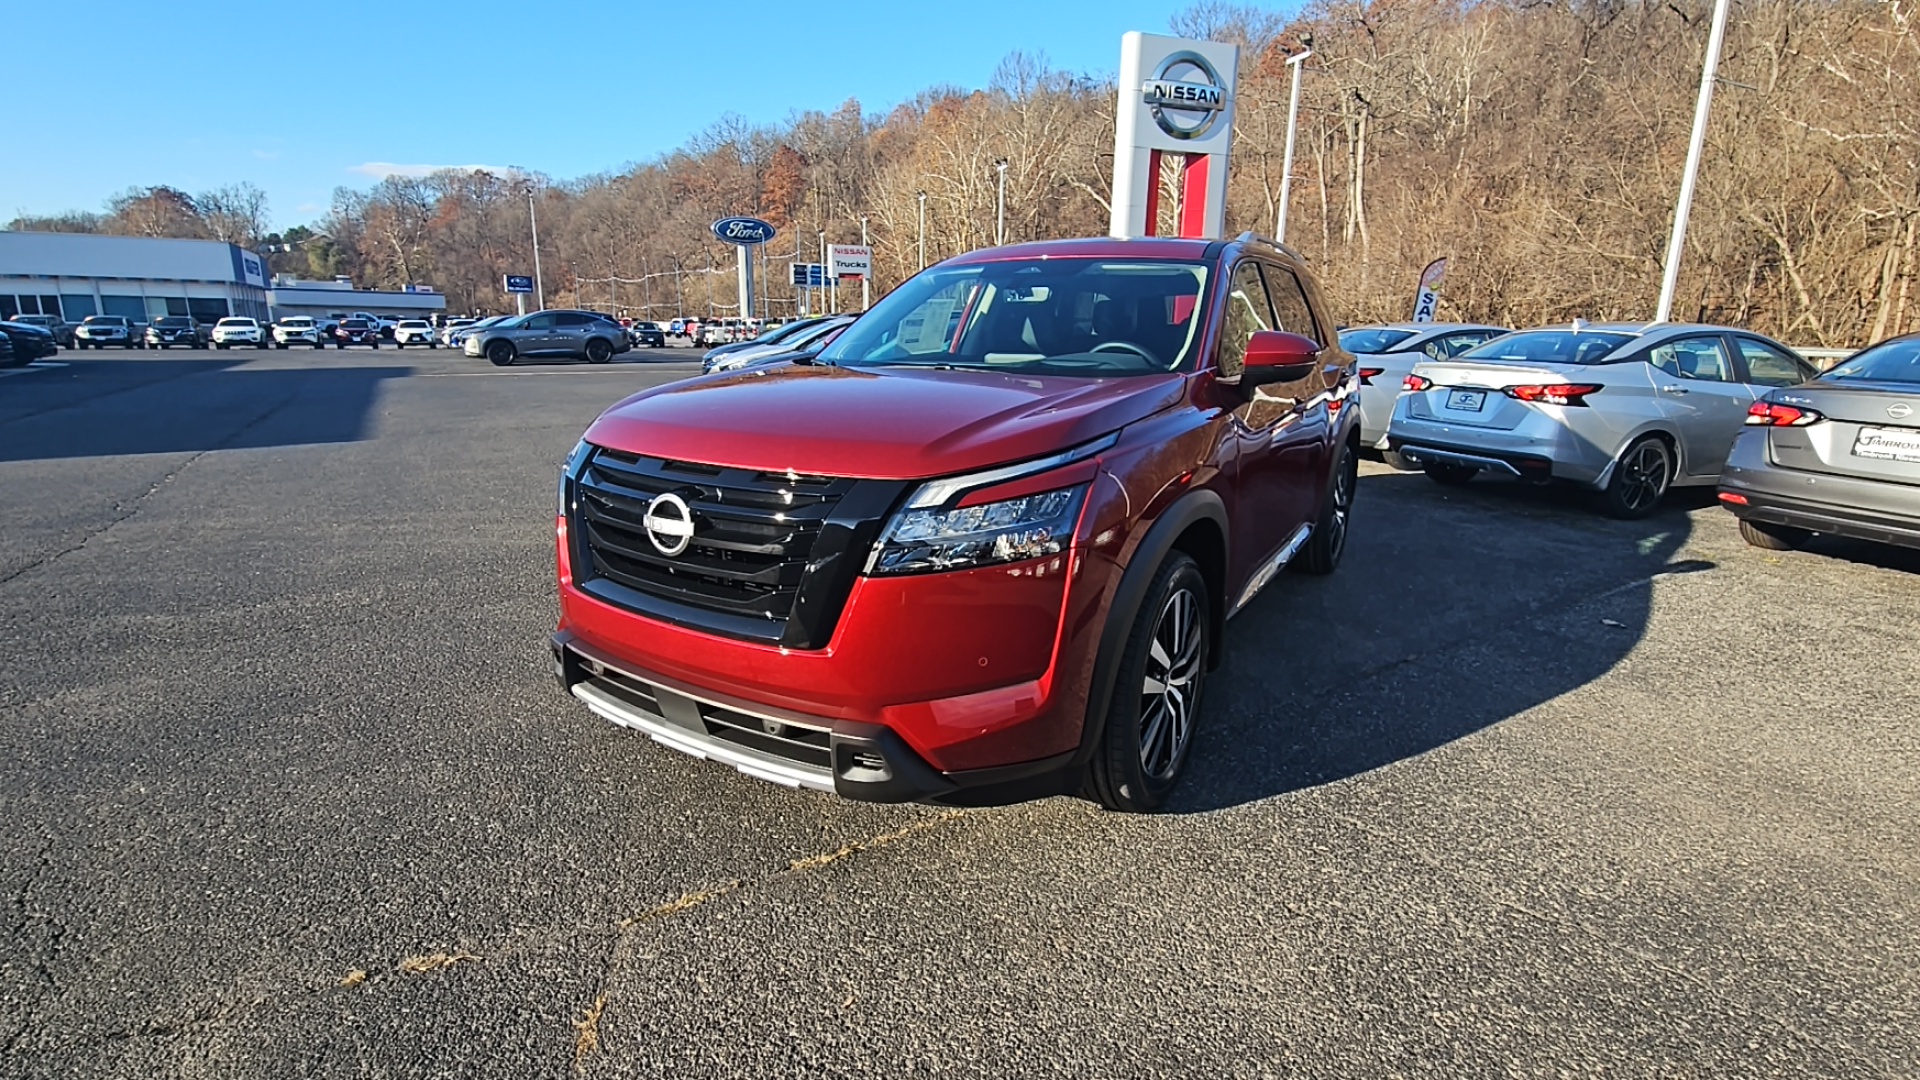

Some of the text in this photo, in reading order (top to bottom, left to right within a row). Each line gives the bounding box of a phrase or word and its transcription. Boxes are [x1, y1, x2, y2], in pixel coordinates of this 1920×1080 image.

[1153, 85, 1220, 104] NISSAN
[726, 221, 763, 239] Ford
[834, 248, 868, 256] NISSAN
[835, 260, 868, 269] Trucks
[1858, 435, 1920, 450] TIMBROO
